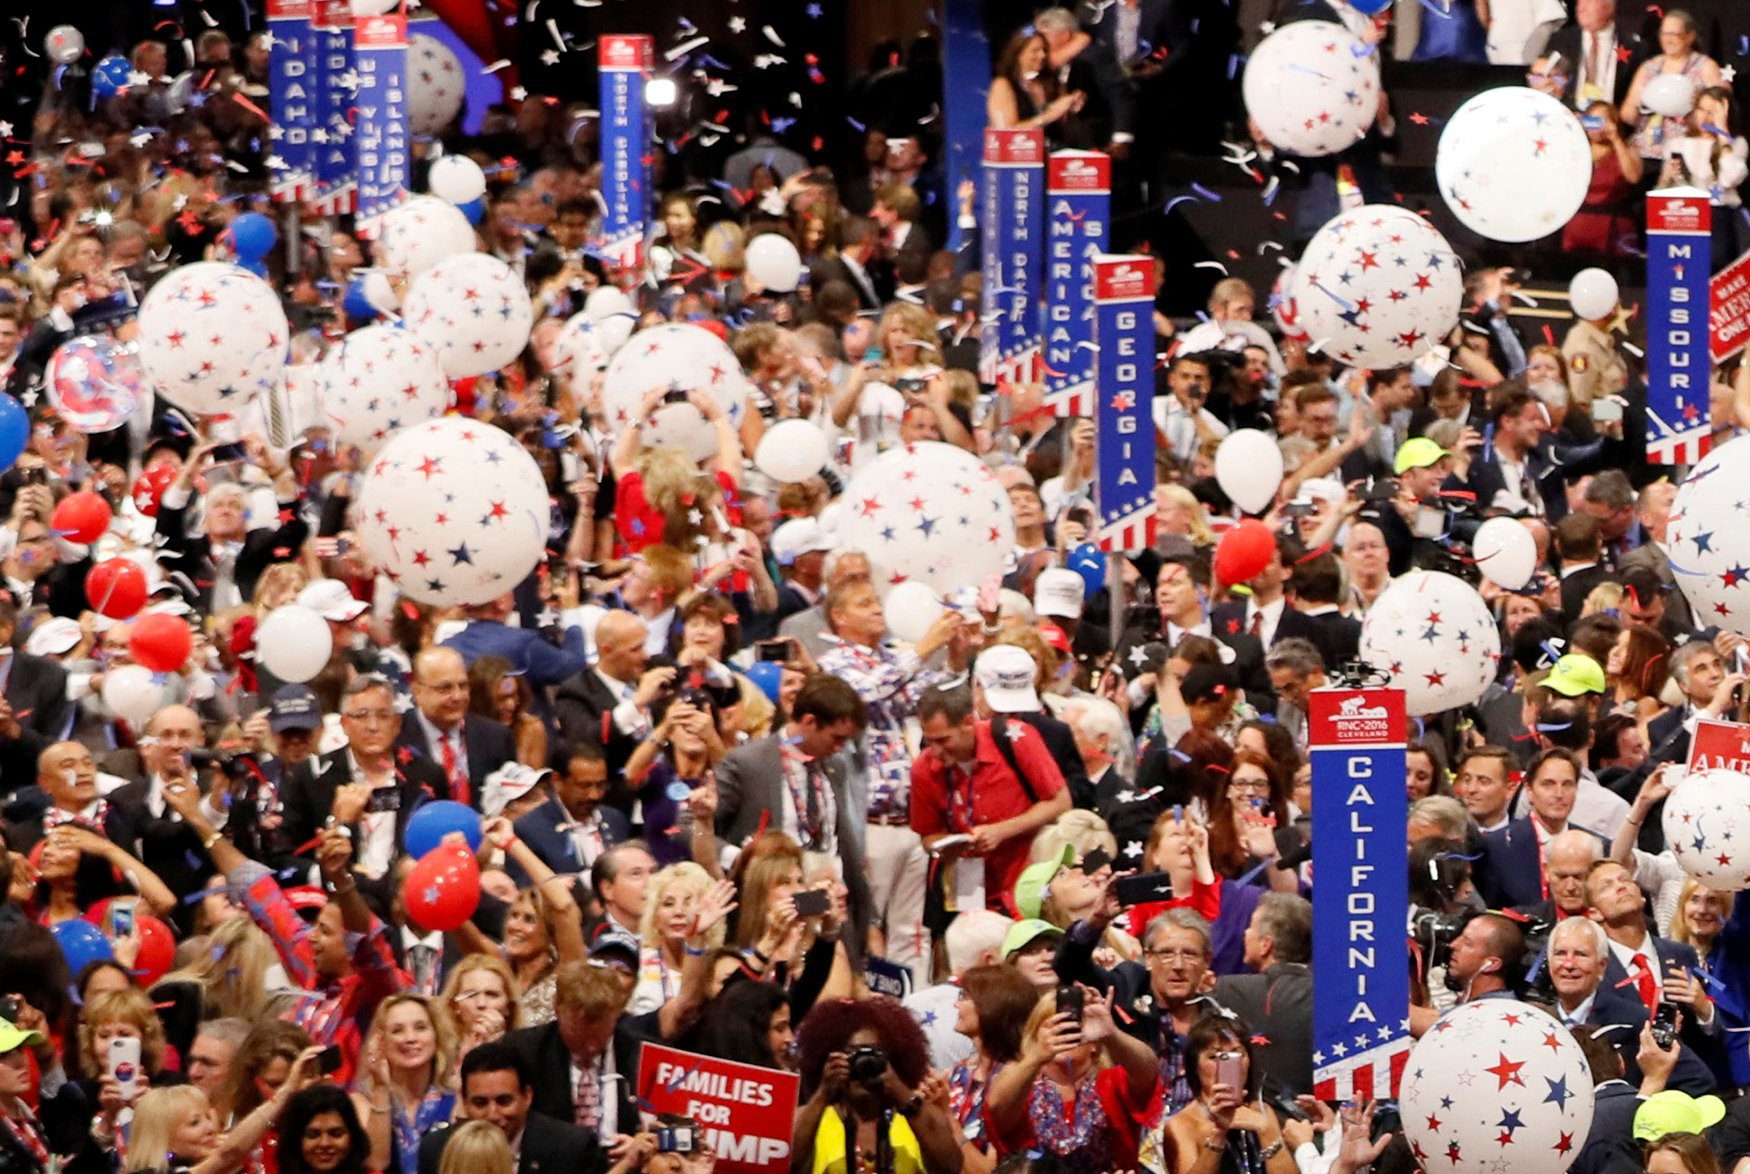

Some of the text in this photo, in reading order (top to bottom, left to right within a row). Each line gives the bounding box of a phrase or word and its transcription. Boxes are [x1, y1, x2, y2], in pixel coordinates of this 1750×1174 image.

[283, 37, 308, 145] IDAHO
[385, 73, 405, 182] ISLANDS
[613, 72, 628, 127] NORTH
[1013, 171, 1029, 241] NORTH
[1051, 199, 1074, 363] AMERICAN
[1667, 244, 1691, 410] MISSOURI
[1116, 311, 1138, 485] GEORGIA
[1345, 756, 1376, 1023] CALIFORNIA
[656, 1062, 774, 1107] FAMILIES
[687, 1099, 732, 1126] FOR
